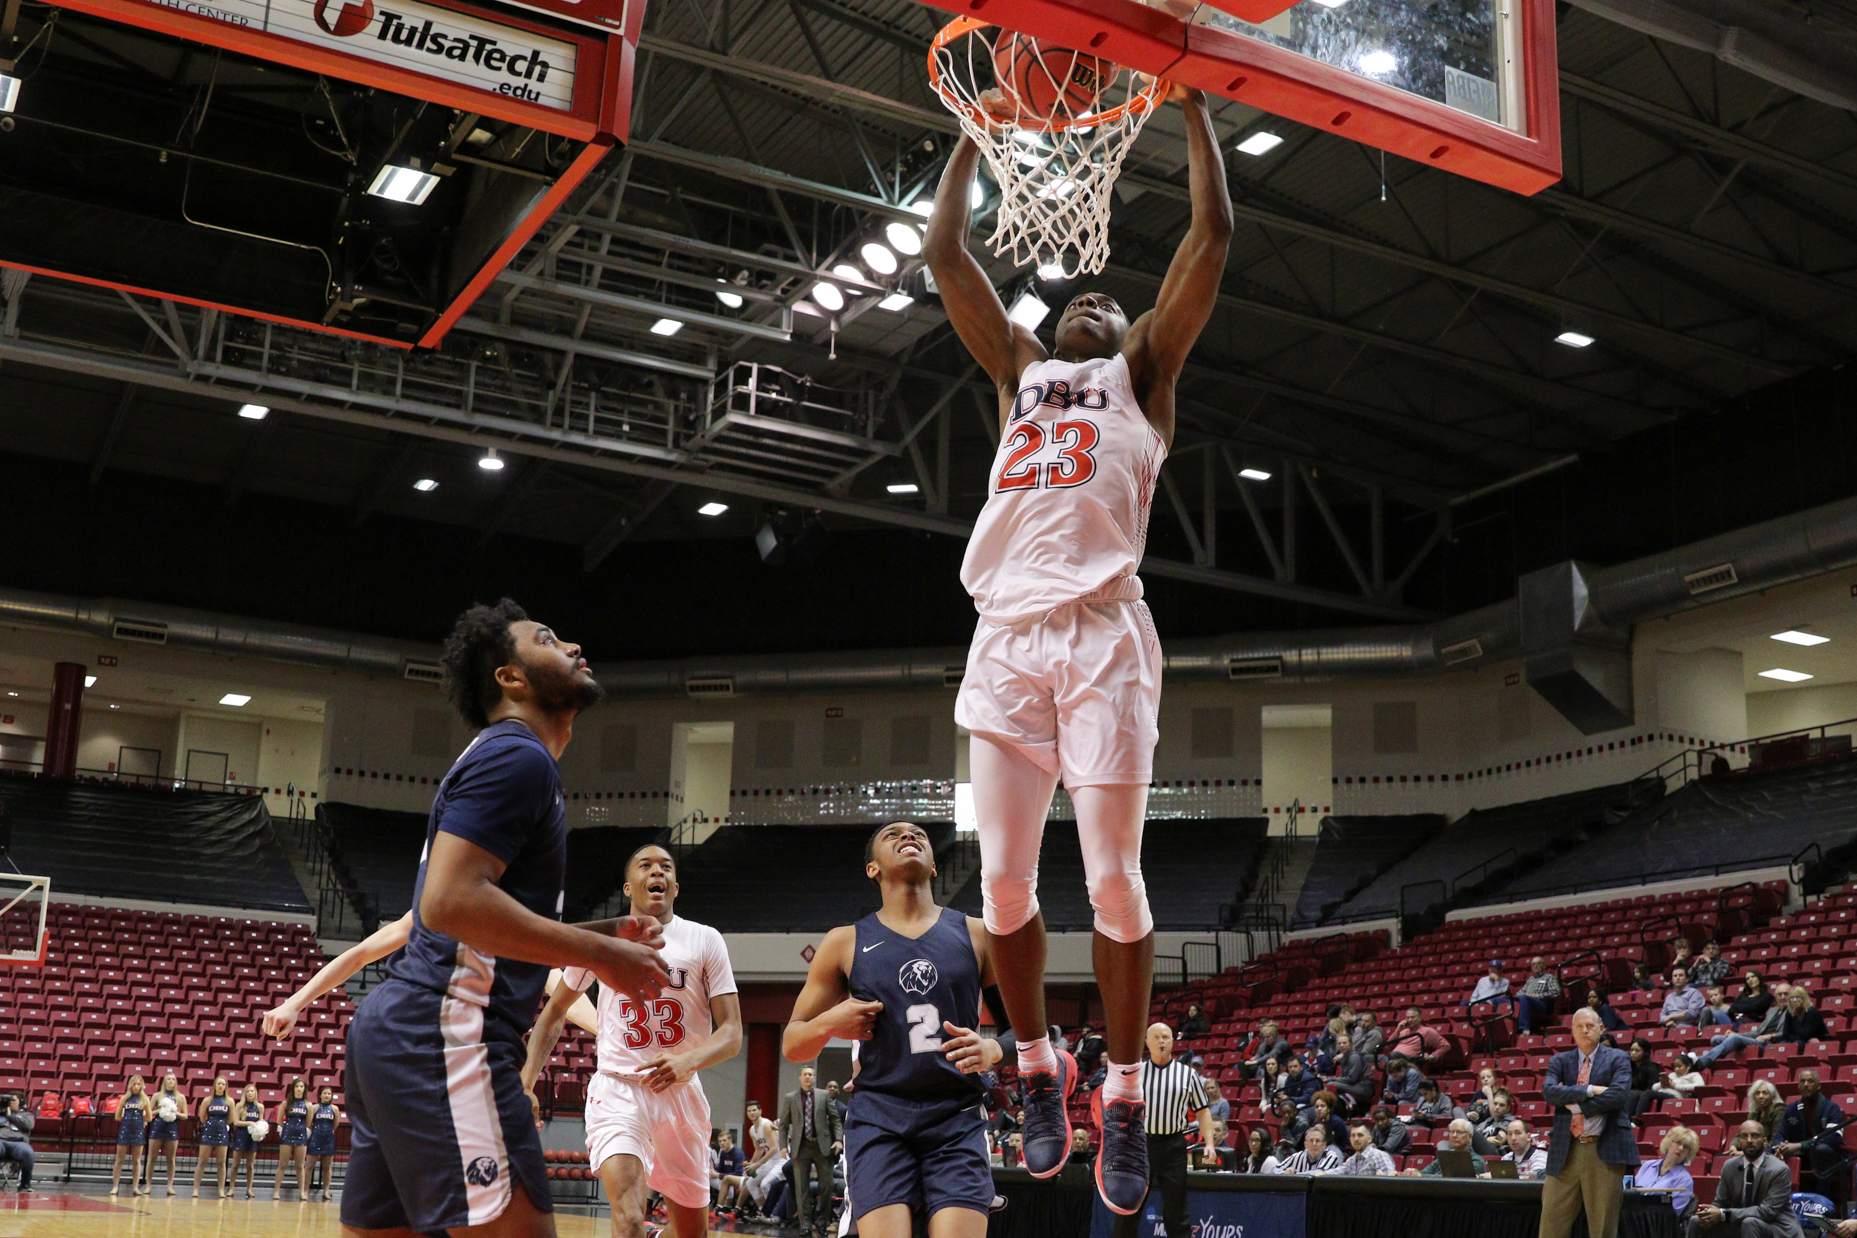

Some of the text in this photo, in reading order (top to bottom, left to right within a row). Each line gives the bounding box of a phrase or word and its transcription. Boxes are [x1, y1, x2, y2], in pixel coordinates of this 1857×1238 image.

[377, 10, 549, 83] TulsaTech
[492, 81, 541, 103] .edu
[1010, 379, 1109, 426] DBU
[995, 418, 1100, 494] 23
[619, 997, 686, 1050] 33
[906, 1003, 942, 1054] 2
[1199, 1215, 1243, 1238] YOURS
